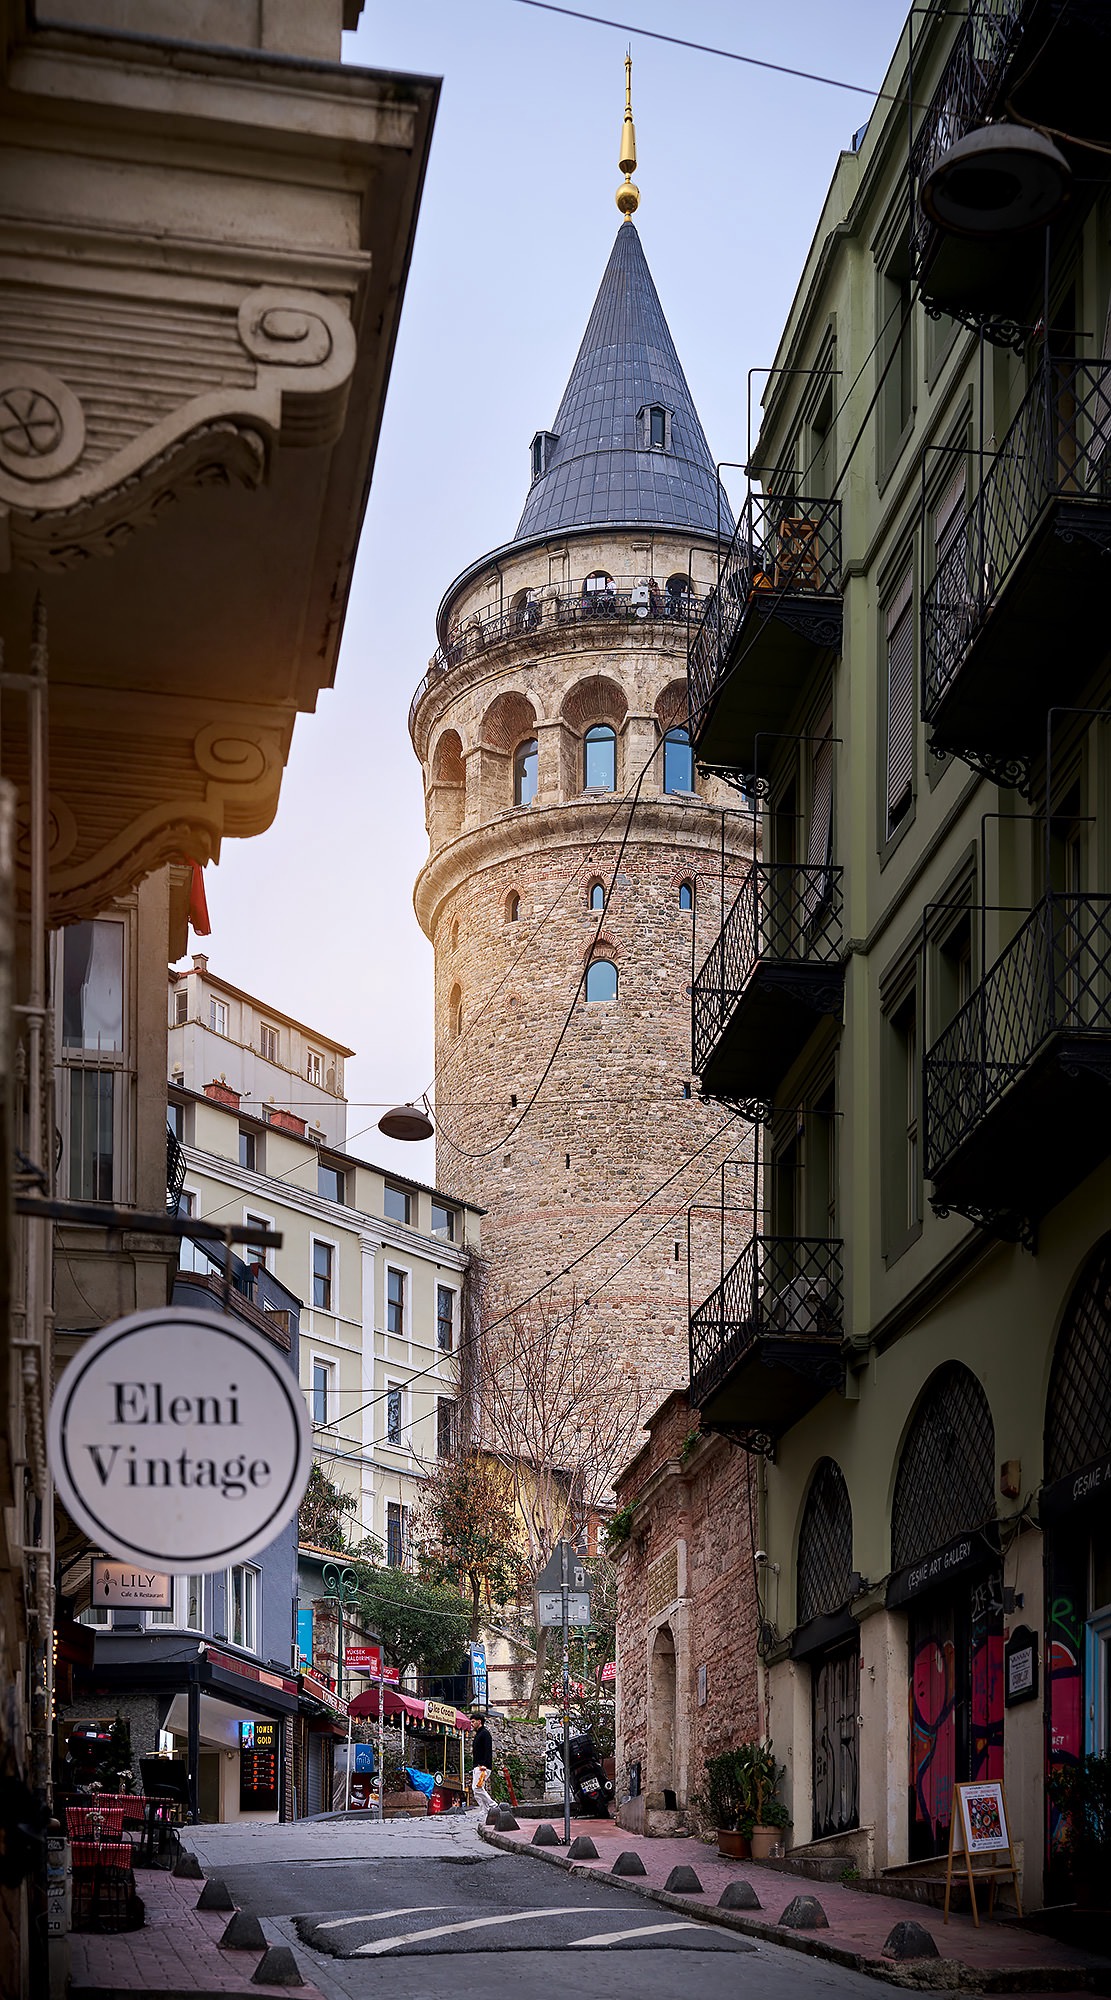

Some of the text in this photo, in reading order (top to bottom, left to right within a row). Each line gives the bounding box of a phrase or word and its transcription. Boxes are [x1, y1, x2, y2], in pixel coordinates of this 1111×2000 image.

[107, 1382, 243, 1426] Eleni
[83, 1444, 272, 1501] Vintage
[929, 1556, 942, 1577] ART
[943, 1540, 972, 1569] GALLERY
[121, 1574, 156, 1588] LILY
[256, 1725, 273, 1734] TOWER
[257, 1736, 272, 1745] GOLD
